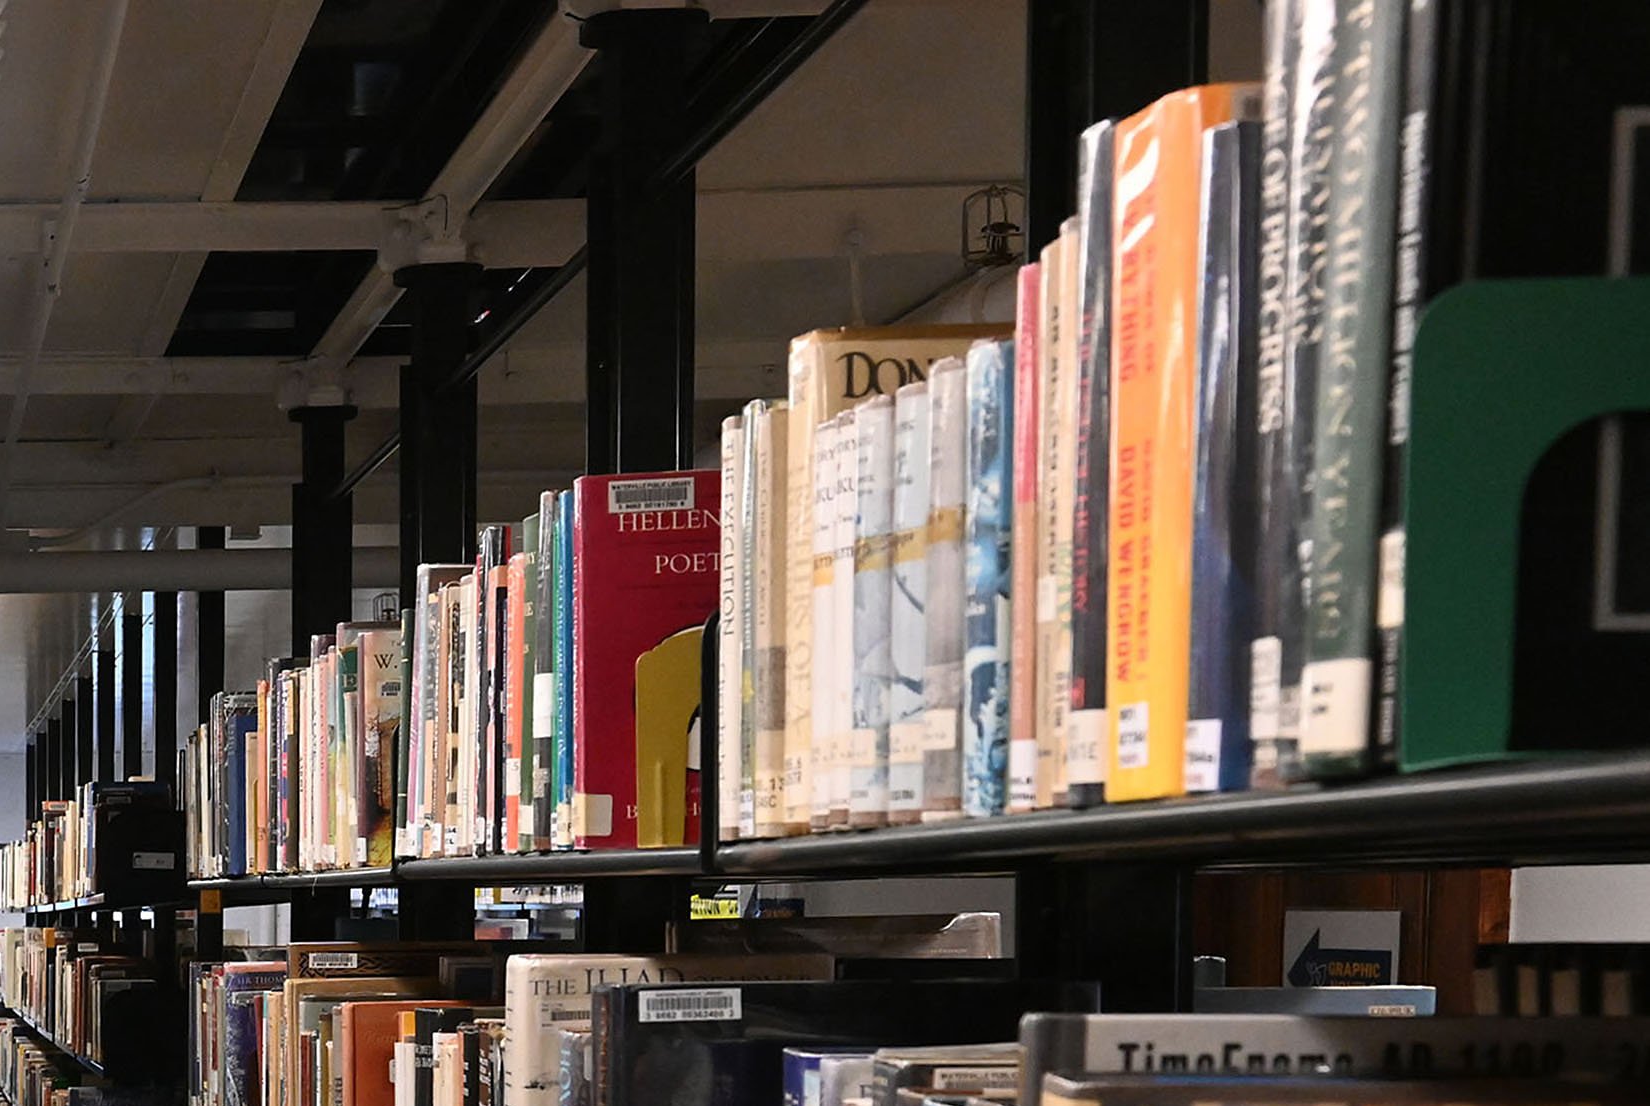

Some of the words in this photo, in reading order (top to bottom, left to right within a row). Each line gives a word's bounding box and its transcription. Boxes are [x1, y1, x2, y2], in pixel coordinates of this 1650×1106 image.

[1117, 446, 1137, 530] DAVID
[722, 479, 736, 638] EXECUTION
[1114, 540, 1136, 683] WENGROW
[529, 978, 576, 997] THE
[1328, 960, 1381, 979] GRAPHIC
